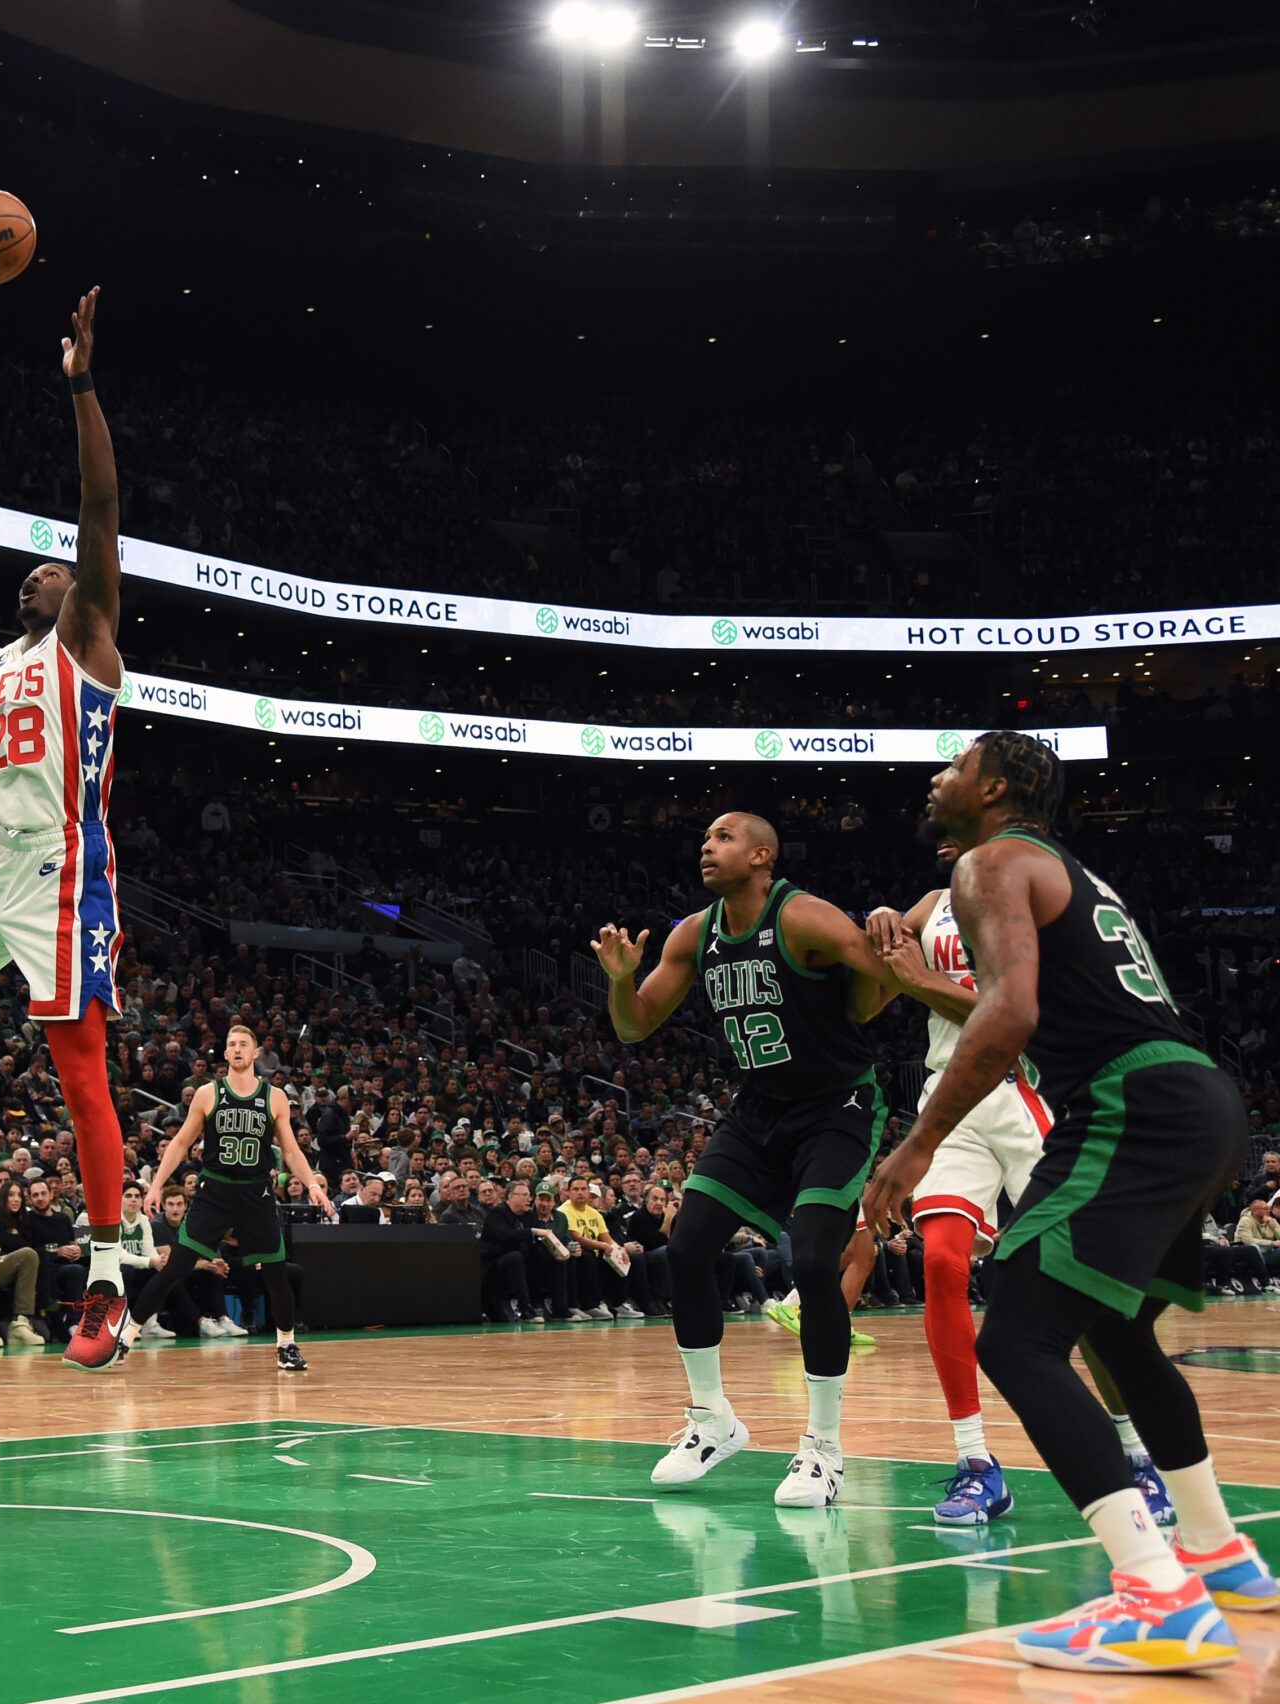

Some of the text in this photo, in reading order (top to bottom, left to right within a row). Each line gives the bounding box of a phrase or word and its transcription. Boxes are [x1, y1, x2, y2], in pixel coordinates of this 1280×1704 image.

[196, 562, 458, 622] HOT CLOUD STORAGE
[563, 615, 630, 636] wasabi
[742, 621, 819, 640] wasabi
[907, 615, 1246, 645] HOT CLOUD STORAGE
[137, 685, 207, 711] wasabi
[281, 708, 361, 730] wasabi
[450, 722, 526, 743] wasabi
[610, 731, 693, 752] wasabi
[789, 732, 874, 753] wasabi
[933, 933, 969, 972] NE
[1092, 904, 1179, 1016] 3
[704, 959, 784, 1013] CELTICS
[723, 1011, 793, 1070] 42
[215, 1107, 267, 1136] CELTICS
[218, 1136, 261, 1167] 30
